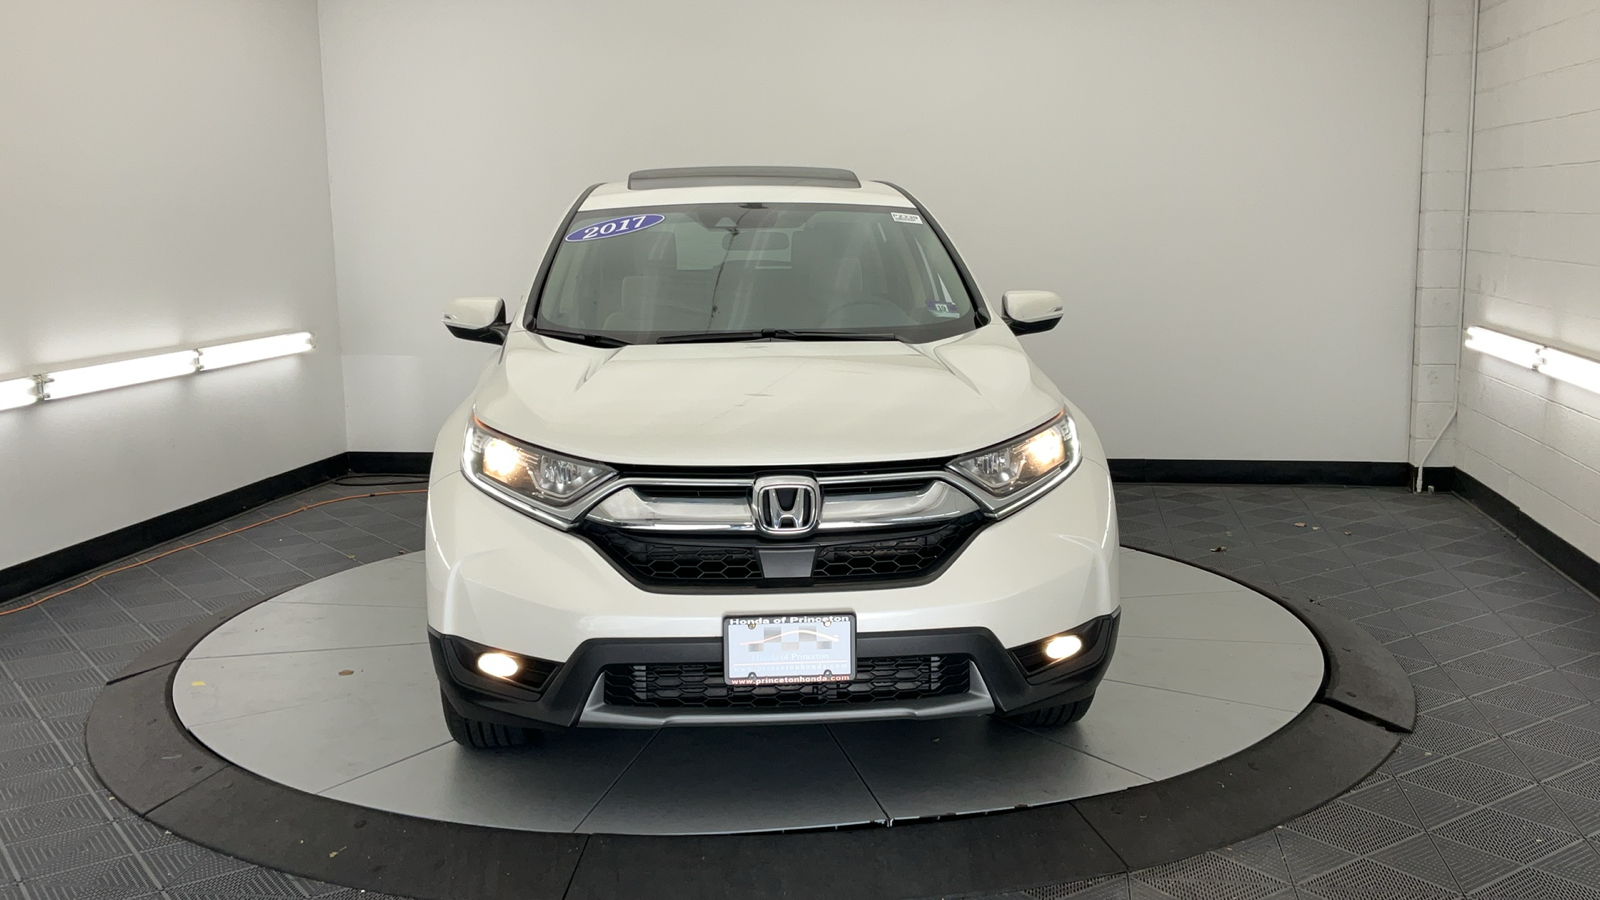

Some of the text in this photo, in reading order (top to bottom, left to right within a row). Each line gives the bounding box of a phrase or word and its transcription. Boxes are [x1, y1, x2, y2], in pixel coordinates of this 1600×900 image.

[582, 215, 647, 240] 2017
[729, 615, 849, 625] Honda of Princeton
[791, 652, 829, 660] Princeton
[731, 674, 850, 686] www.princetonhonda.com
